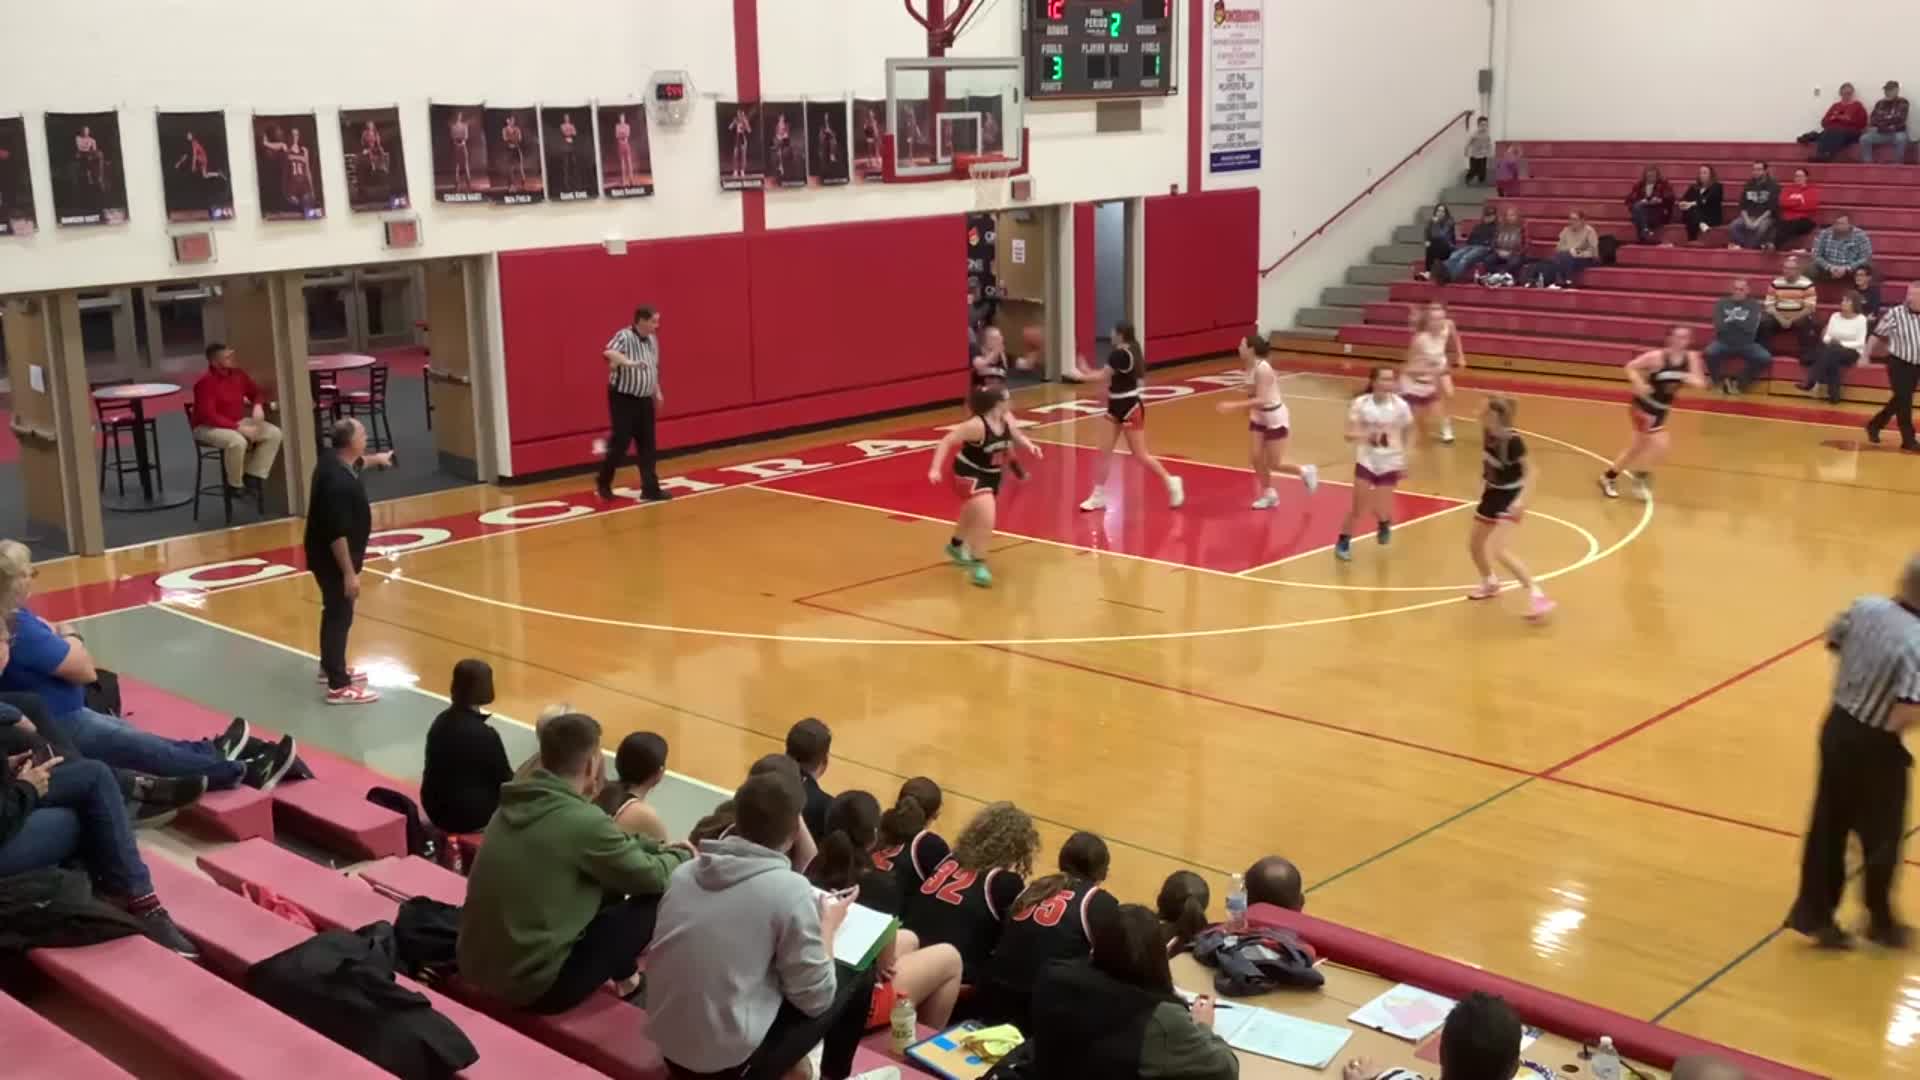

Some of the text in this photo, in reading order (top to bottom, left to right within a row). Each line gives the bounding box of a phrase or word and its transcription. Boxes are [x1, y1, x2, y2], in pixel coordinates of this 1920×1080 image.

[1084, 17, 1108, 28] PERIOD
[1110, 12, 1121, 37] 2
[1041, 43, 1063, 54] FOULS
[1081, 43, 1106, 54] PLAYER
[1141, 42, 1160, 53] FOULS
[1051, 55, 1063, 80] 3
[1154, 55, 1160, 76] 1
